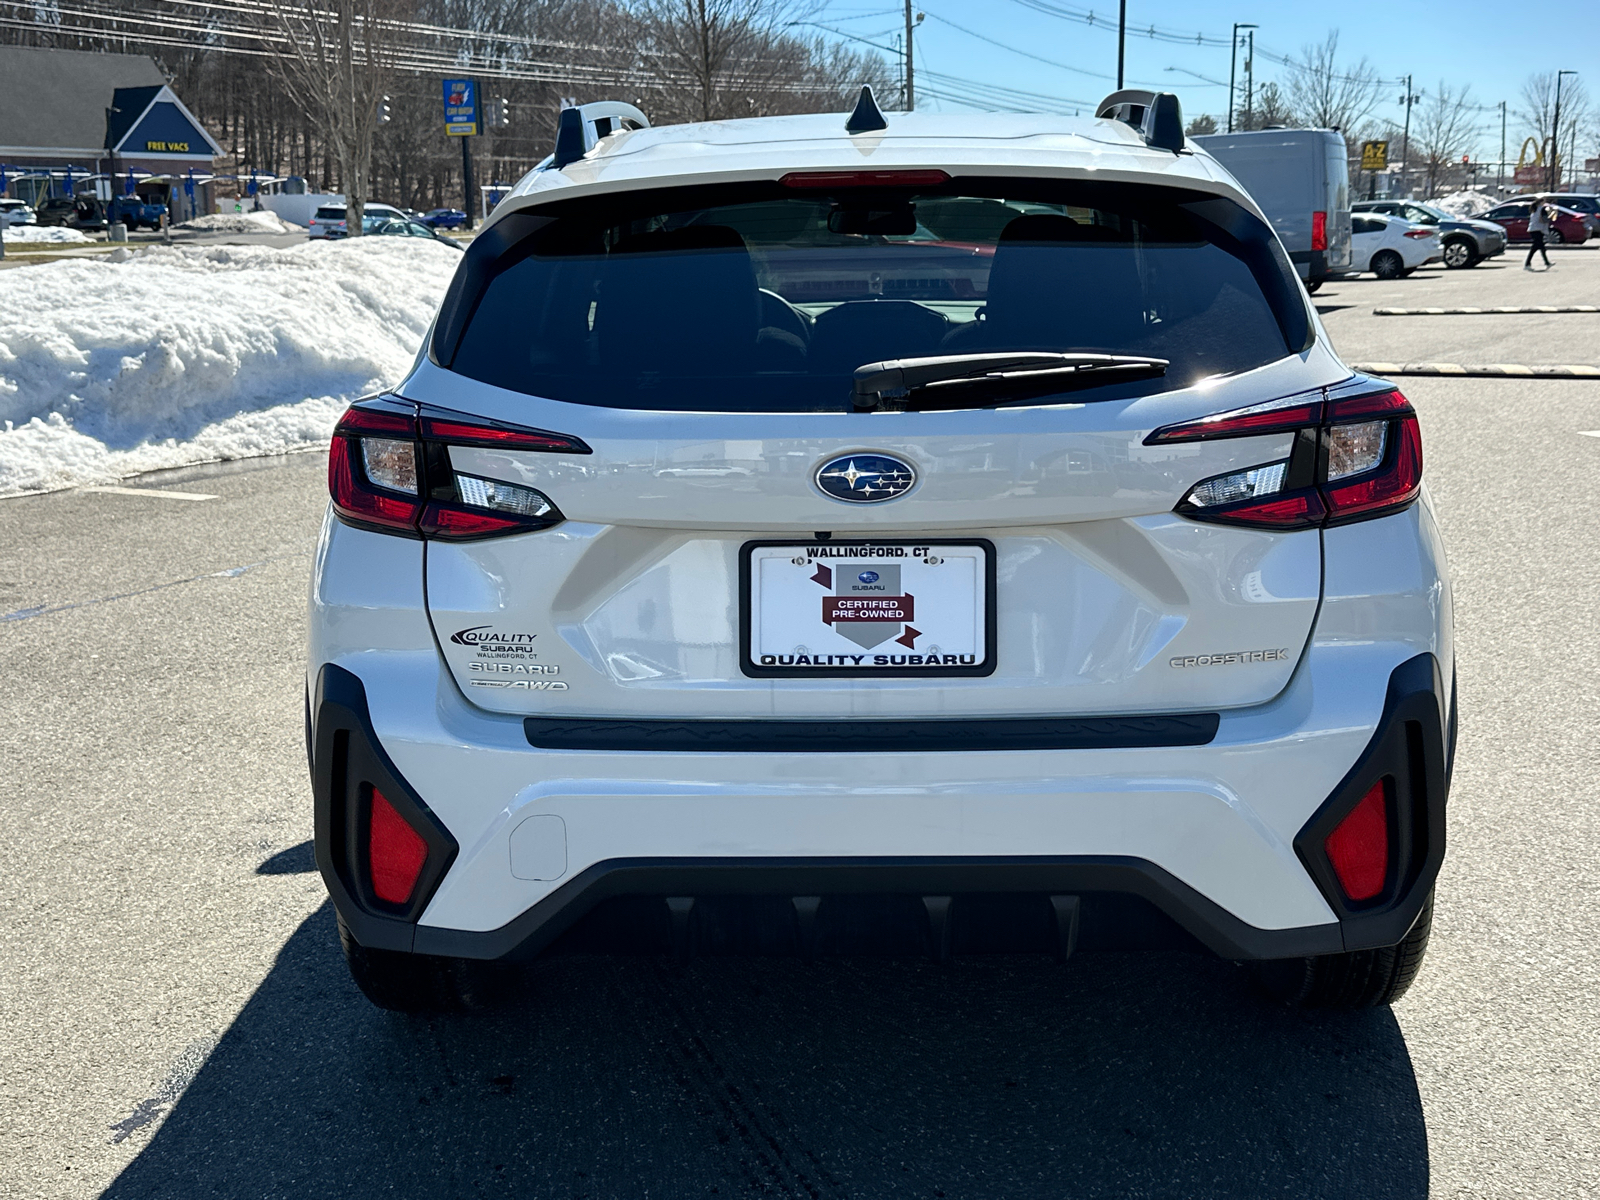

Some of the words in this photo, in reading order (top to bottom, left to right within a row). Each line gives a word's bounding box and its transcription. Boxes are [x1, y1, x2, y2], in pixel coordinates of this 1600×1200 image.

[147, 141, 165, 151] FREE
[168, 142, 189, 152] VACS
[1363, 143, 1386, 157] A-Z
[806, 547, 909, 559] WALLINGFORD,
[912, 547, 930, 557] CT
[838, 600, 899, 609] CERTIFIED
[832, 610, 904, 618] PRE-OWNED
[465, 632, 538, 643] QUALITY
[480, 645, 533, 653] SUBARU
[476, 652, 527, 660] WALLINGFORD,
[760, 654, 863, 666] QUALITY
[873, 654, 976, 665] SUBARU
[1169, 647, 1289, 668] CROSSTREK
[468, 661, 560, 676] SUBARU
[507, 679, 570, 691] AWD
